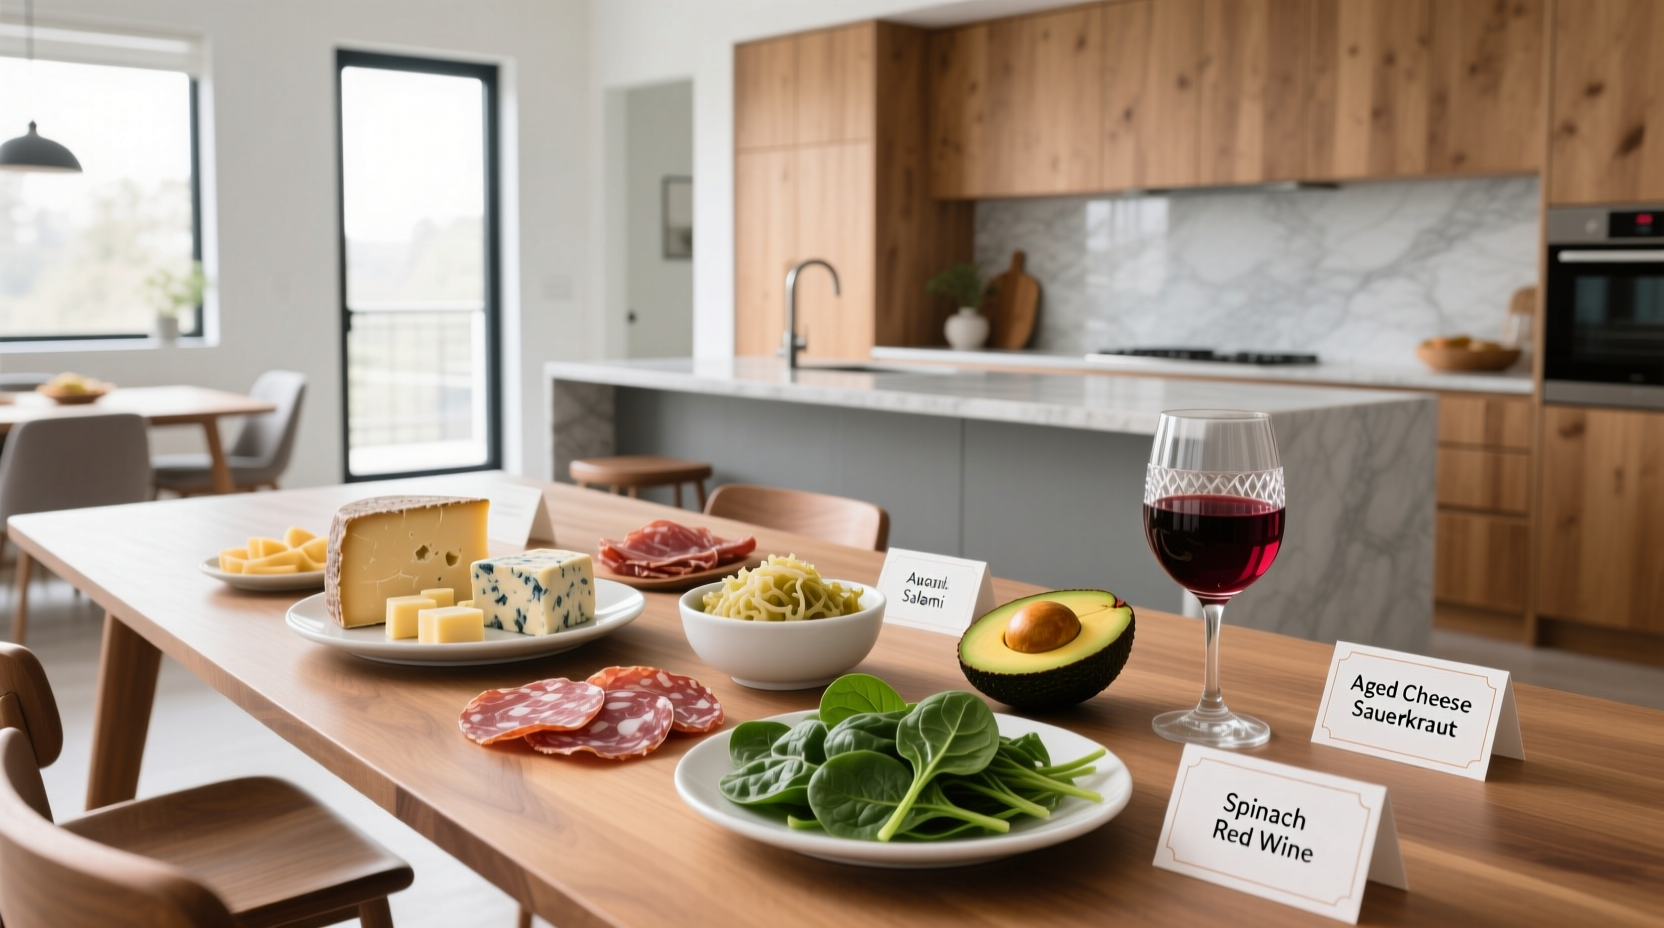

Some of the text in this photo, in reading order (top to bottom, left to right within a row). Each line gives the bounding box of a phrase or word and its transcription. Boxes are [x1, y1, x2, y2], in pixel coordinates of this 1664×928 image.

[902, 588, 945, 609] Salami
[1350, 674, 1472, 714] Aged Cheese
[1351, 699, 1458, 738] Sauerkraut
[1223, 792, 1306, 831] Spinach
[1212, 818, 1314, 863] Red Wine
